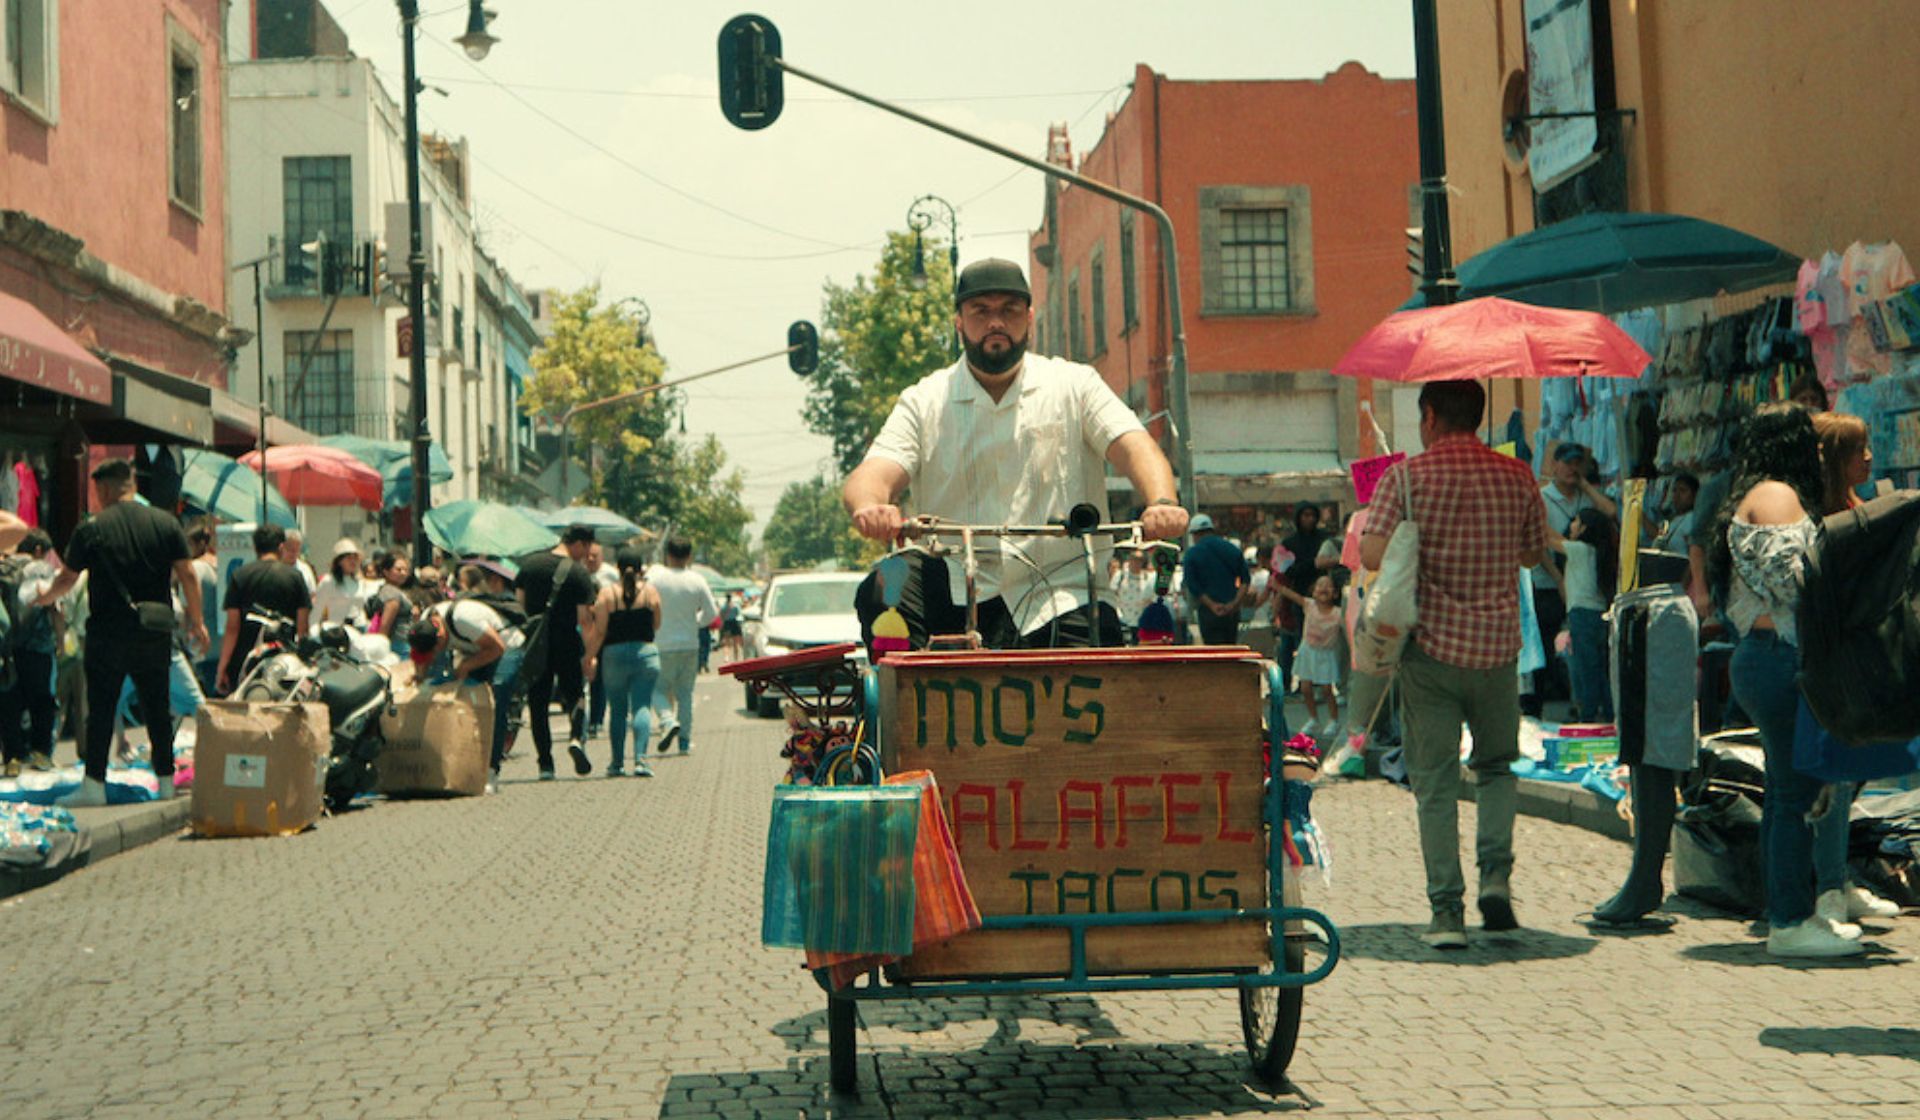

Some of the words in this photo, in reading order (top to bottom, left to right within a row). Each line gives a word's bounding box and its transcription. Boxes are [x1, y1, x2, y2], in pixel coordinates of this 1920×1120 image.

[913, 675, 1106, 750] MO'S
[939, 772, 1256, 852] ALAFEL
[1009, 868, 1240, 914] TACOS
